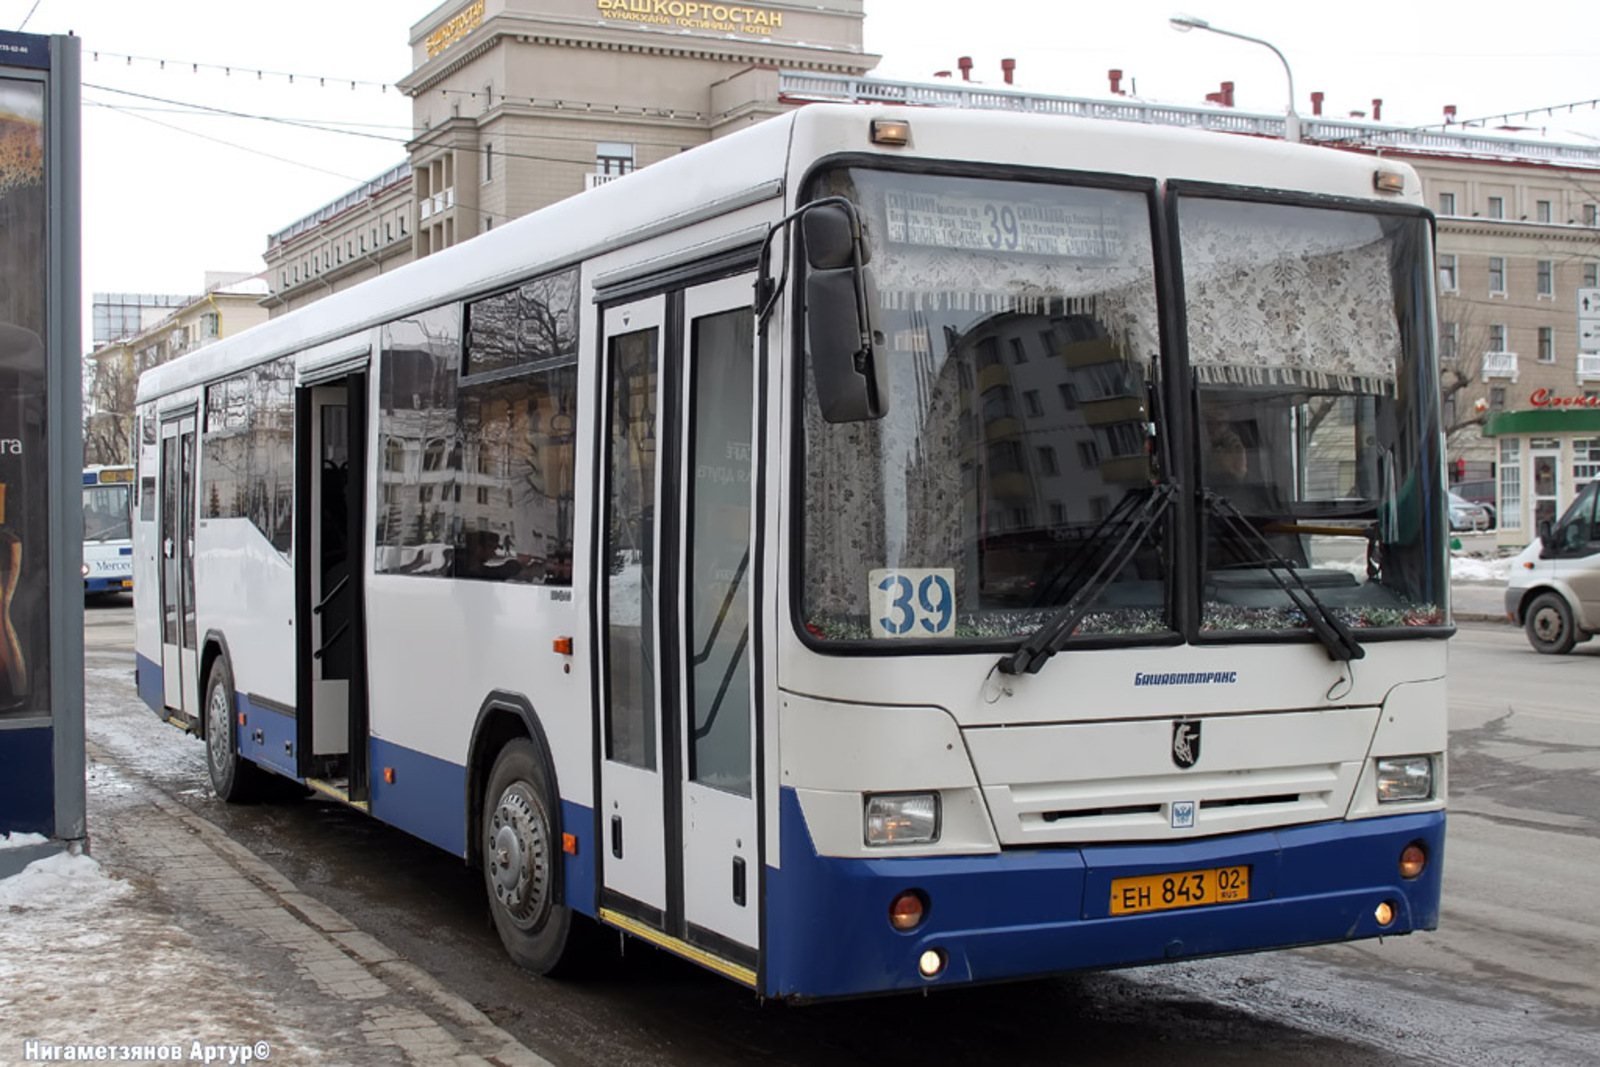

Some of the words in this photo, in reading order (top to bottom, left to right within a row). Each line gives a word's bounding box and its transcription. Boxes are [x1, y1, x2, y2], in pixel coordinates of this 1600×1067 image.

[984, 203, 1018, 249] 39
[878, 574, 953, 635] 39
[1122, 886, 1151, 909] ЕН
[1161, 874, 1205, 904] 843
[1218, 869, 1240, 890] 02
[1221, 890, 1238, 899] RUS
